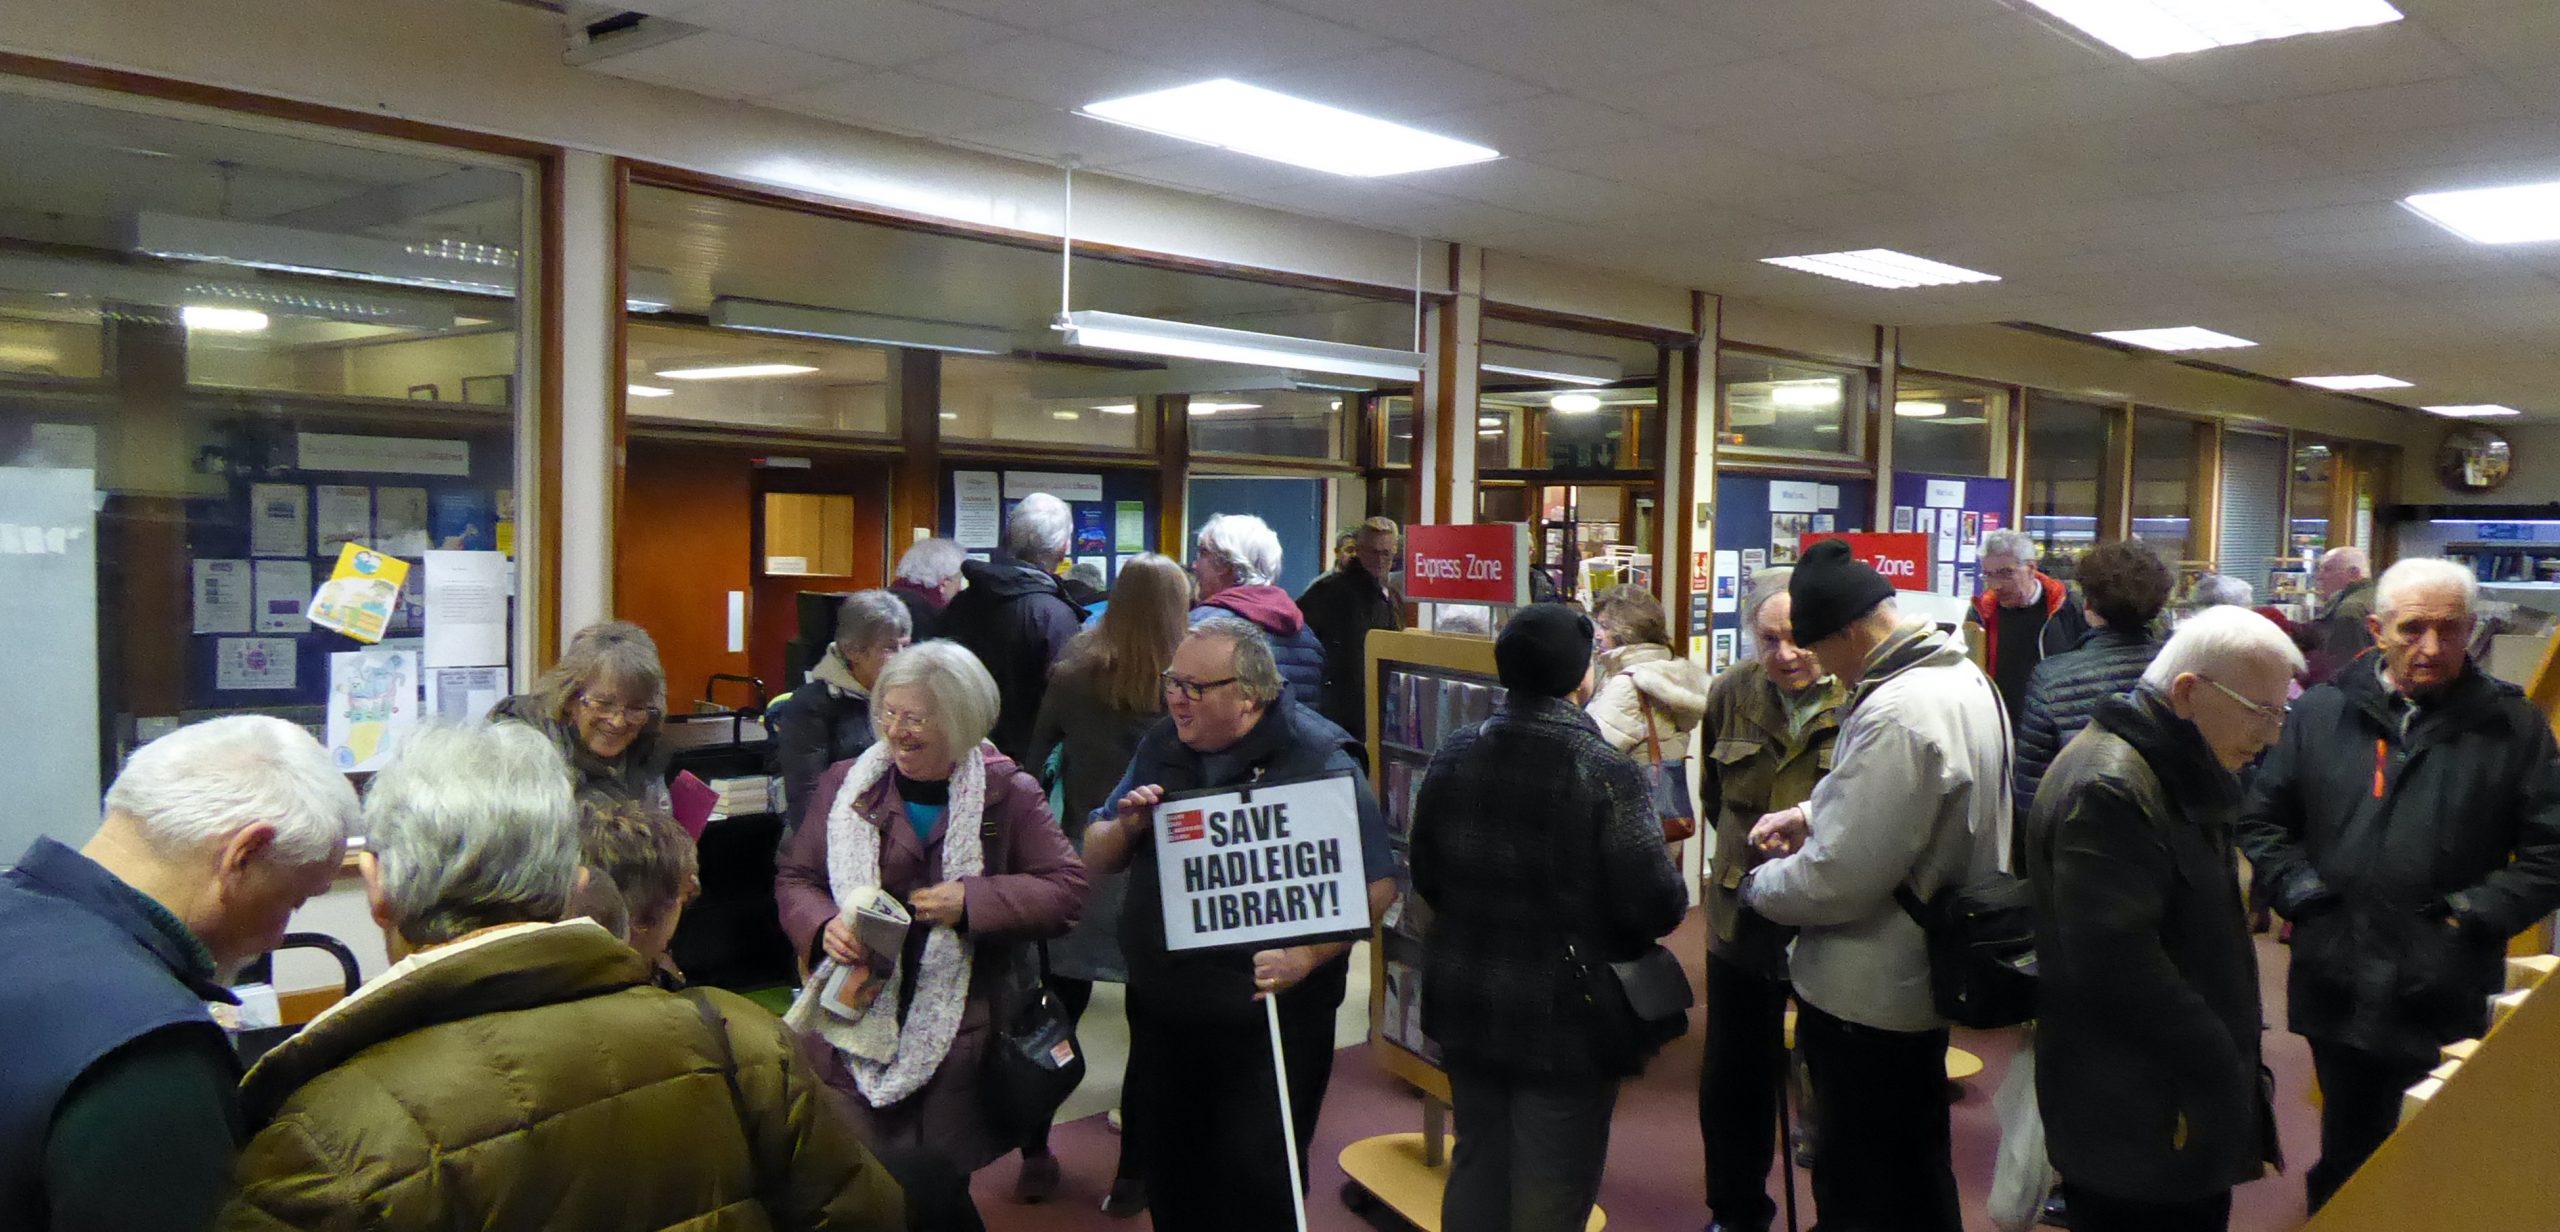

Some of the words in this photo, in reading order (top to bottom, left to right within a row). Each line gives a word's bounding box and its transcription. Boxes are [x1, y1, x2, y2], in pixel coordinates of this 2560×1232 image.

[1415, 553, 1462, 585] Express
[1465, 553, 1503, 581] Zone
[1874, 555, 1916, 577] Zone
[1208, 803, 1292, 848] SAVE
[1184, 838, 1342, 893] HADLEIGH
[1191, 880, 1341, 934] LIBRARY!
